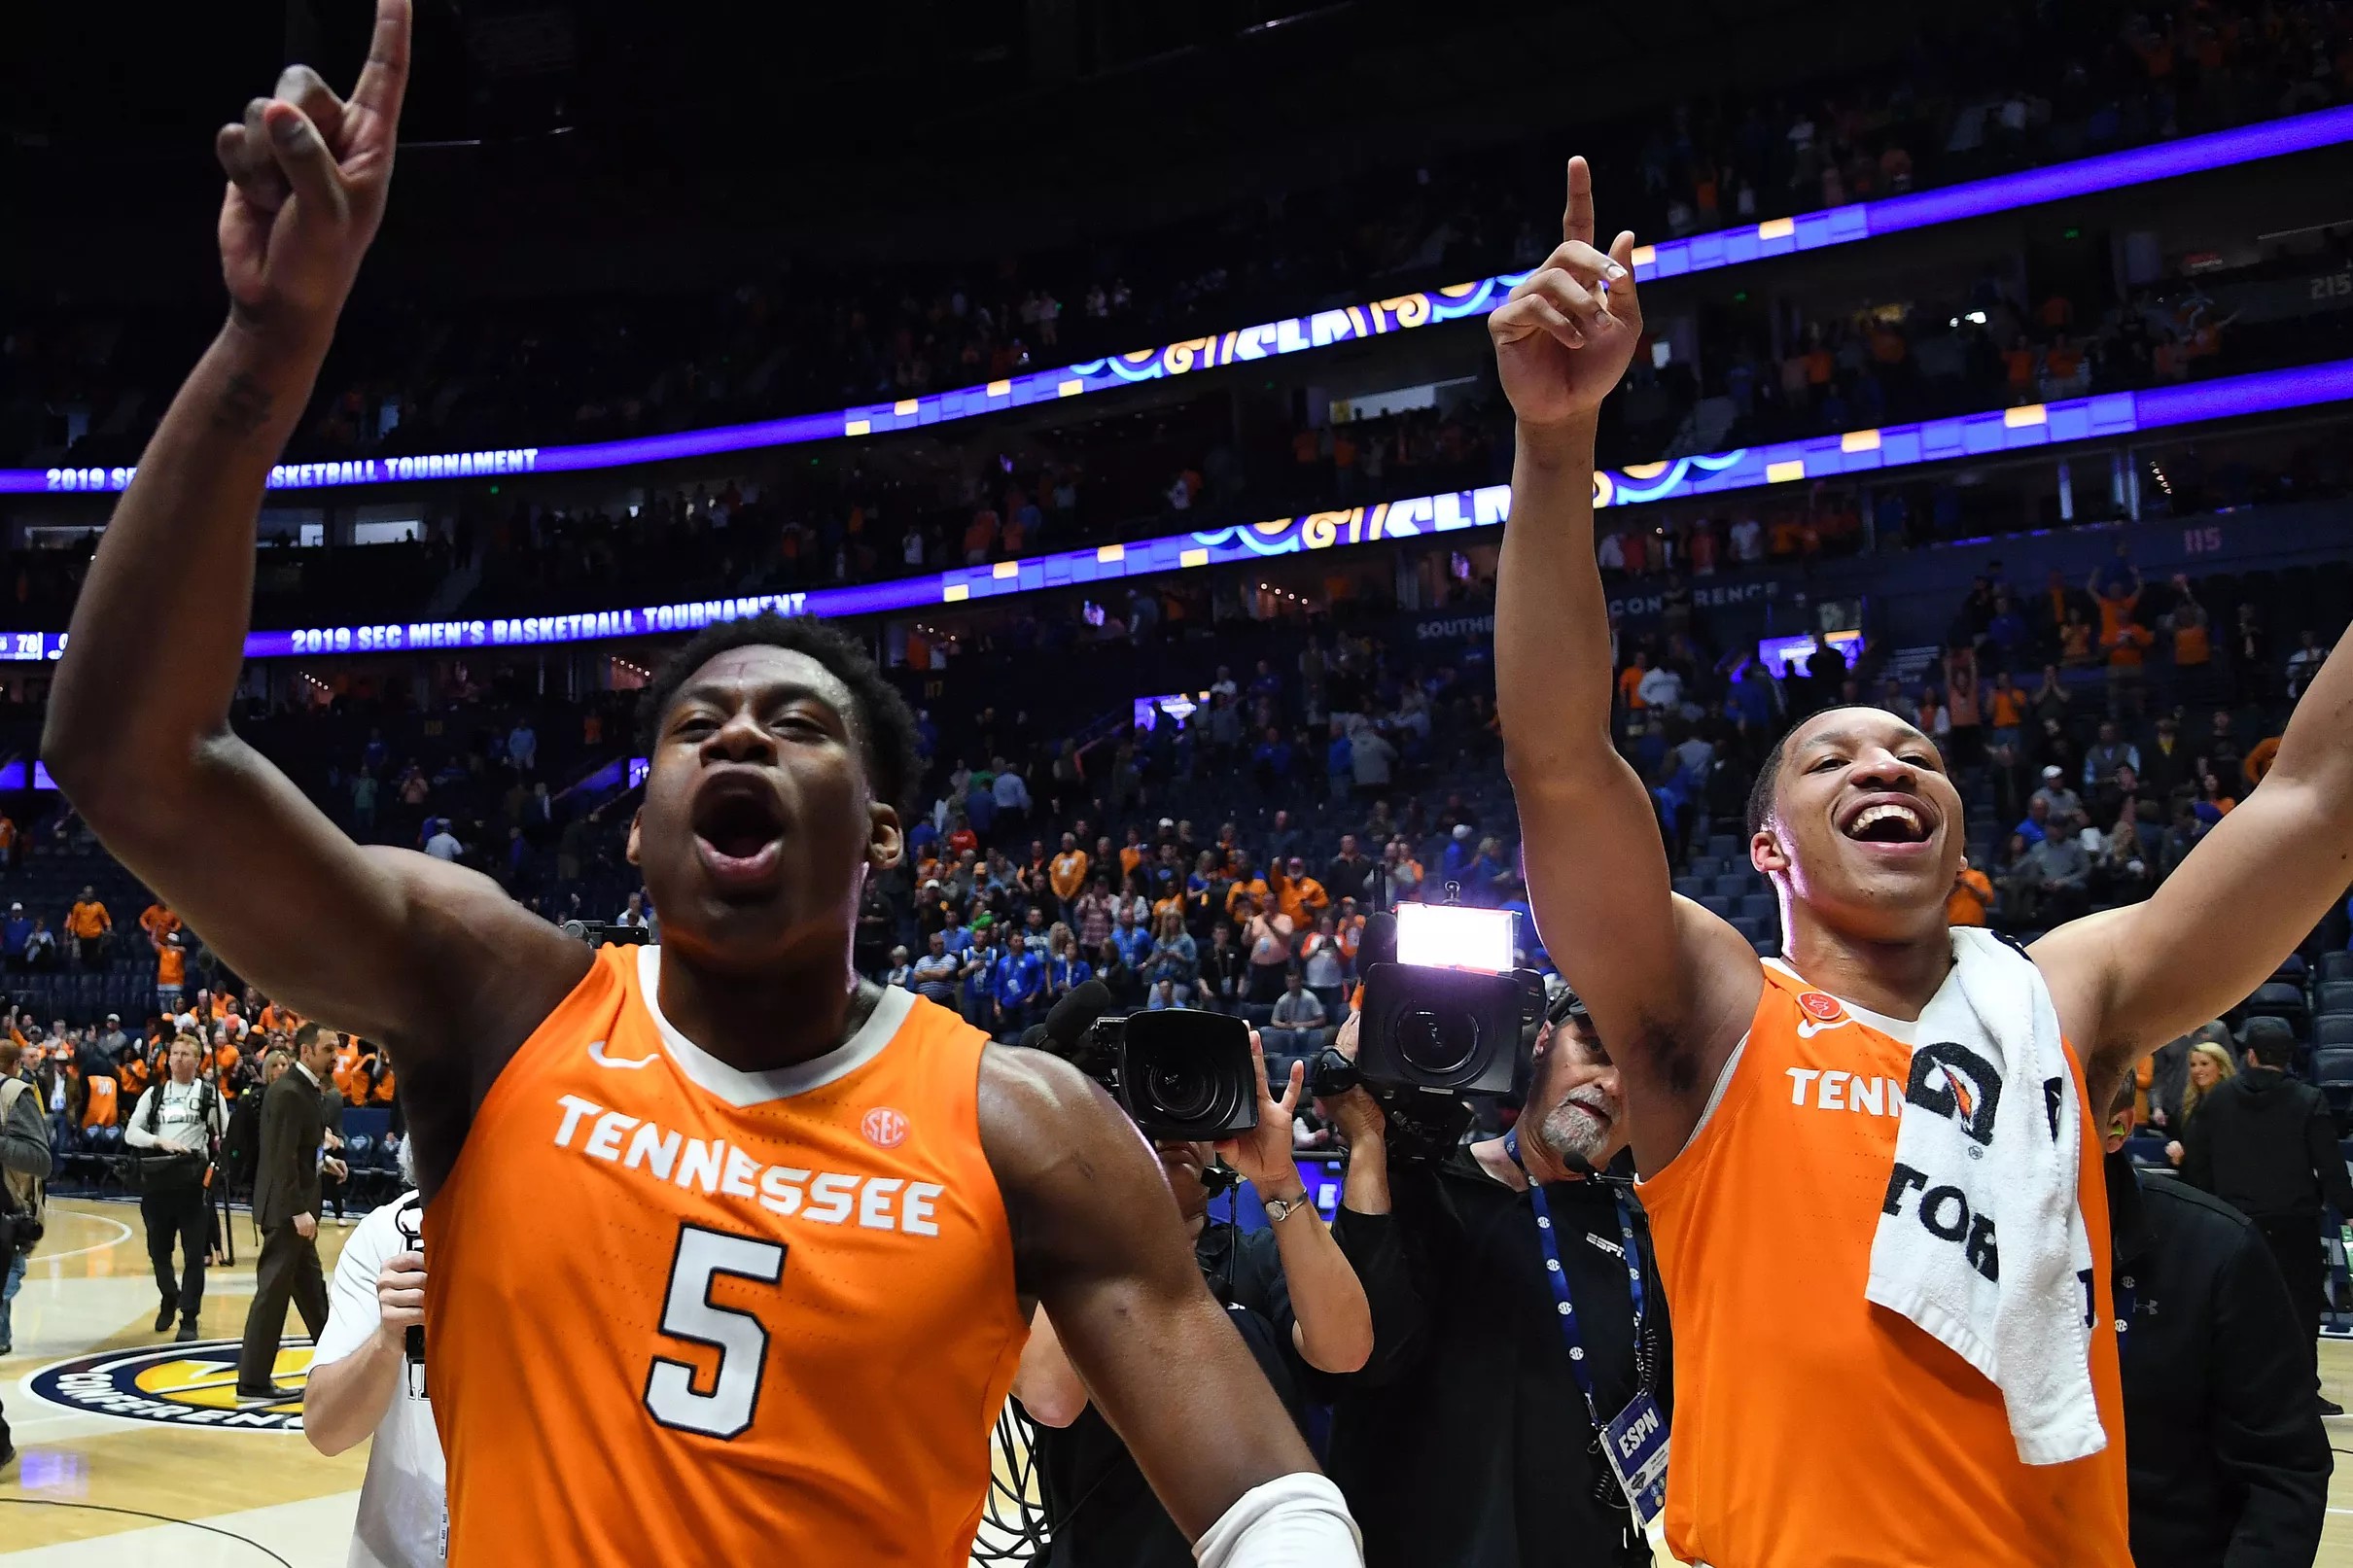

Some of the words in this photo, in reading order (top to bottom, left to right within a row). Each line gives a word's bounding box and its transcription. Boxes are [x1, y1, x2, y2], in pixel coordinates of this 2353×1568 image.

[47, 468, 106, 490] 2019
[265, 460, 378, 488] SKETBALL
[385, 448, 539, 480] TOURNAMENT
[2185, 527, 2222, 552] 115
[292, 627, 351, 653] 2019
[357, 625, 403, 649] SEC
[408, 620, 486, 648] MEN'S
[492, 610, 637, 644] BASKETBALL
[643, 593, 806, 631] TOURNAMENT
[1785, 1067, 1906, 1117] TENN
[865, 1109, 906, 1145] SEC
[553, 1094, 945, 1237] TENNESSEE
[643, 1222, 789, 1442] 5
[1618, 1407, 1659, 1459] ESPN
